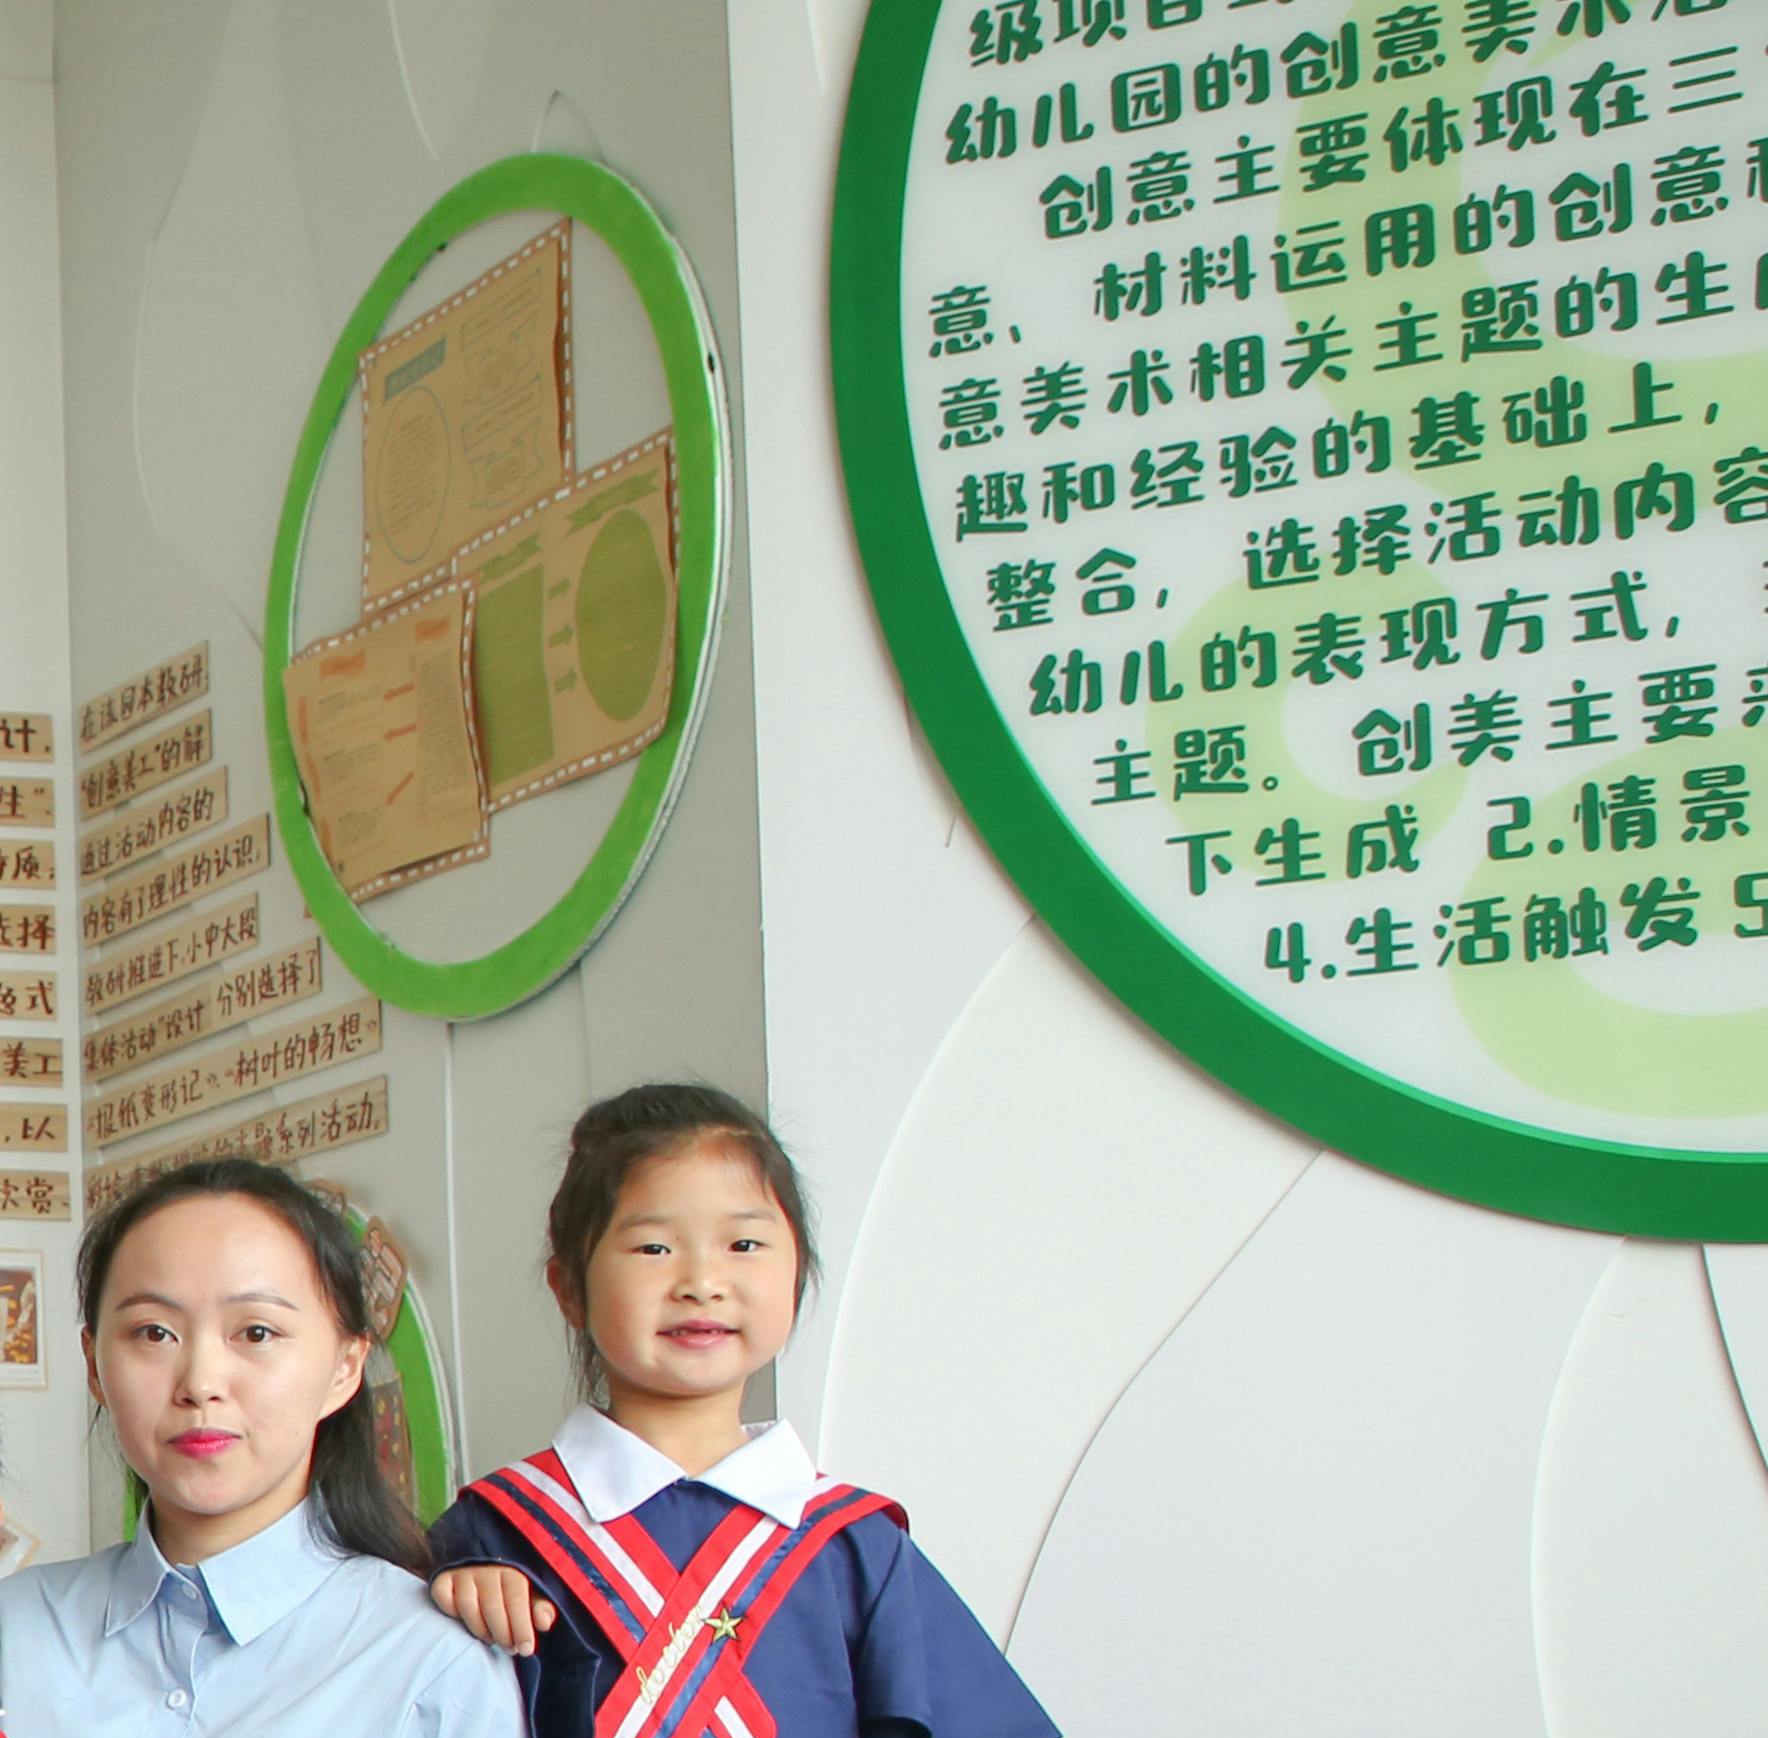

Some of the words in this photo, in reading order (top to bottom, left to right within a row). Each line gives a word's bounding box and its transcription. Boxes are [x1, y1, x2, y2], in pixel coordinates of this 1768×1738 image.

[945, 0, 1727, 165] 幼儿园的创意美术
[1038, 44, 1768, 241] 创意主要体现在三
[927, 137, 1768, 358] 意、材料运用的创意
[938, 250, 1768, 451] 意美术相关主题的生
[1028, 561, 1768, 719] 幼儿的表现方式，
